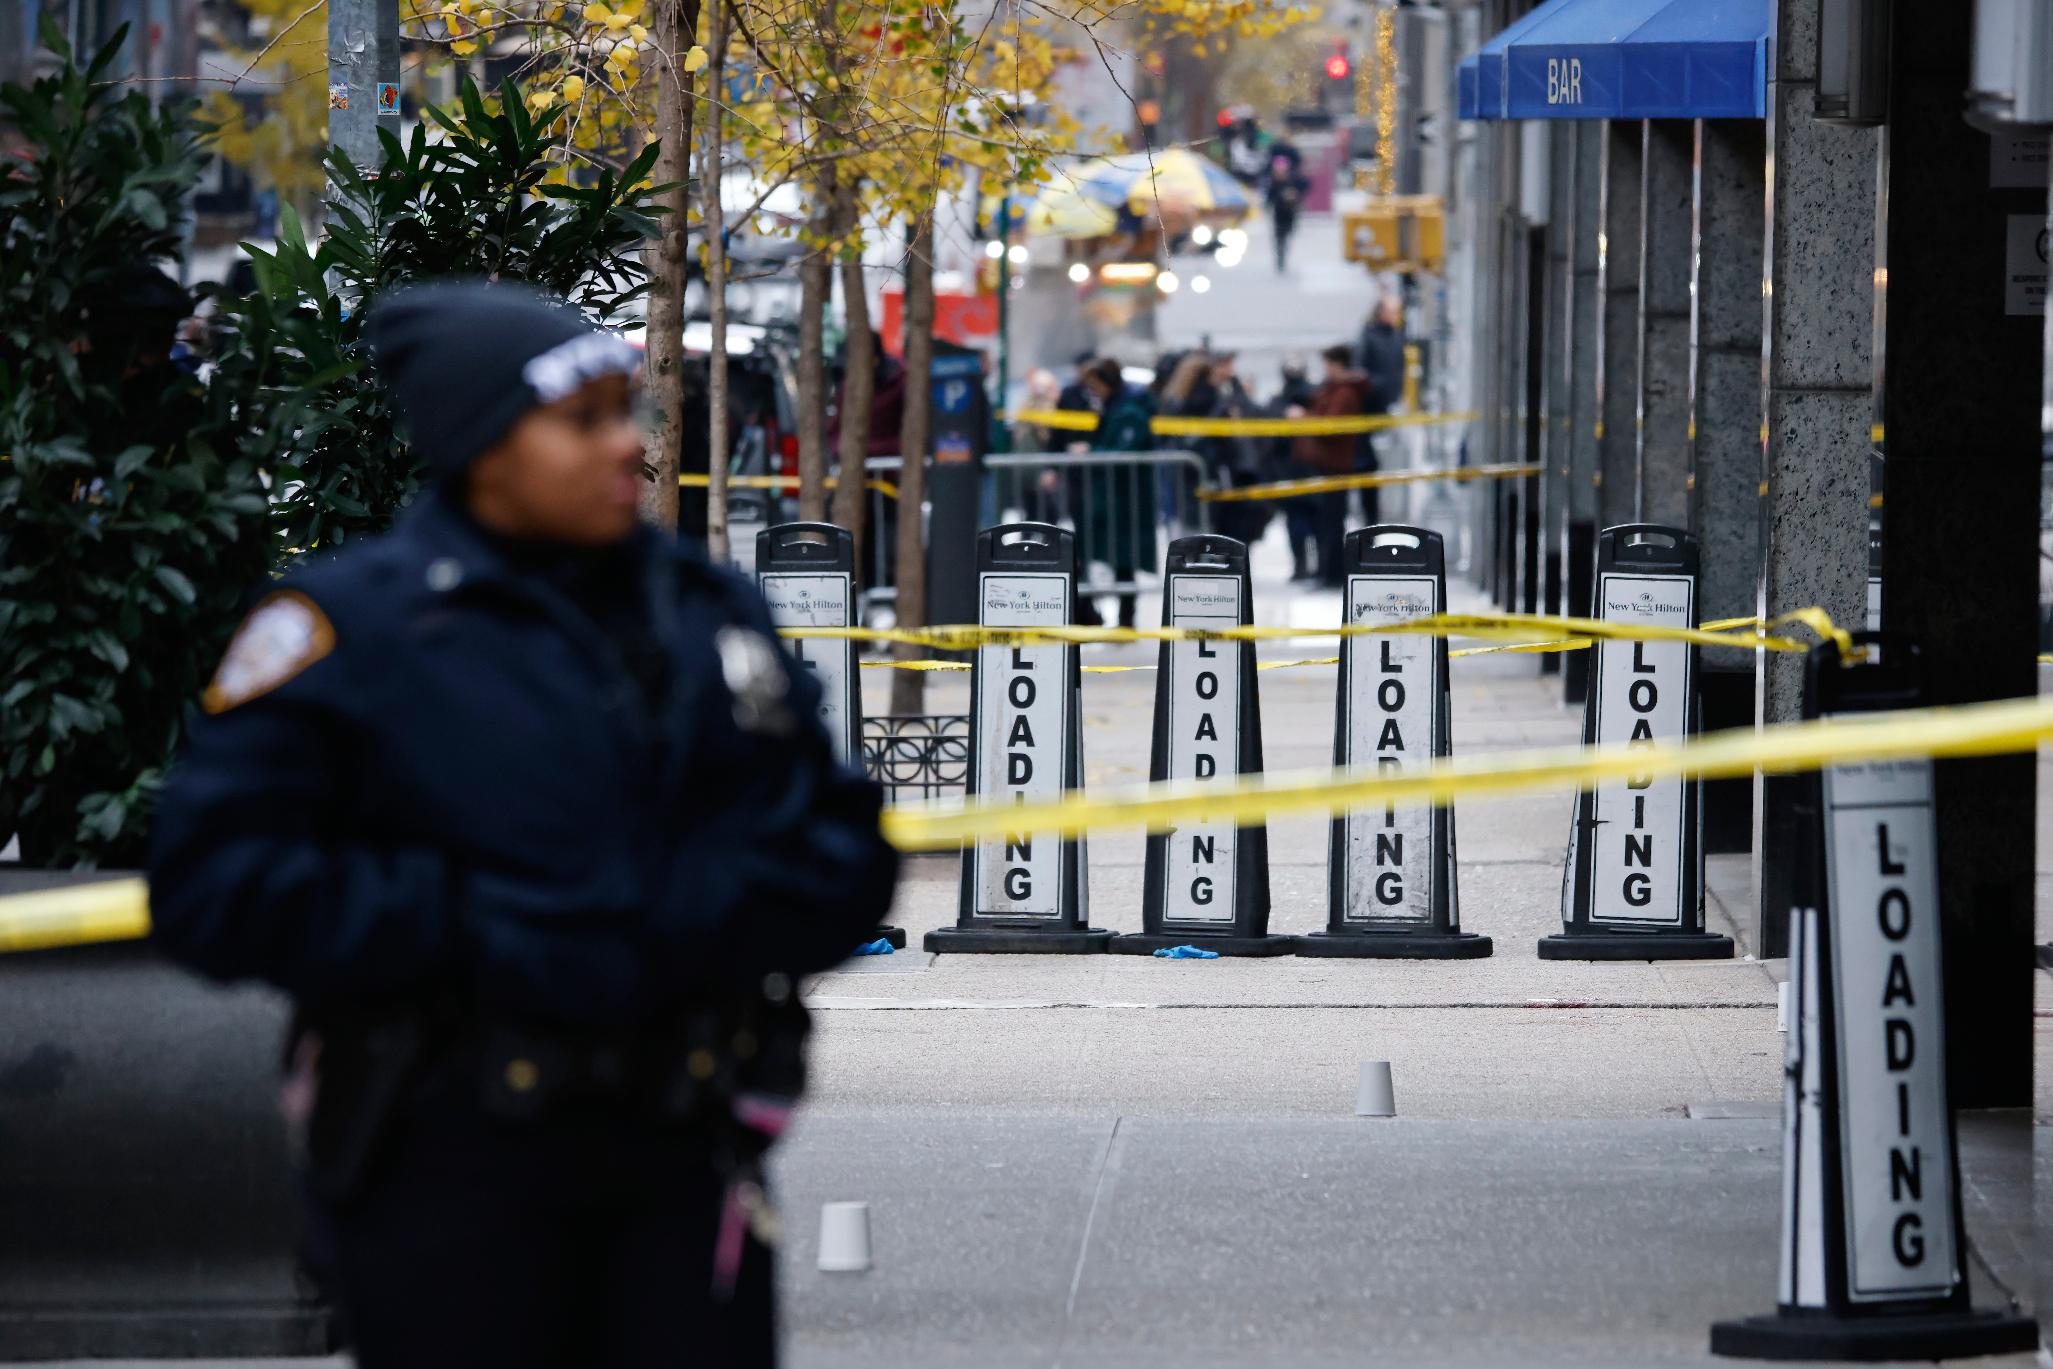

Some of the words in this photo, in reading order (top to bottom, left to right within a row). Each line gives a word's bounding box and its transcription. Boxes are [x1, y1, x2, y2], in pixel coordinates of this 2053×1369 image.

[1548, 58, 1582, 104] BAR
[1177, 595, 1194, 603] New
[1196, 595, 1212, 603] York
[1213, 595, 1236, 603] Hilton
[768, 601, 788, 609] New
[790, 601, 811, 609] York
[813, 600, 843, 609] Hilton
[987, 600, 1007, 609] New
[1010, 601, 1030, 610] York
[1033, 601, 1062, 610] Hilton
[1356, 603, 1376, 611] New
[1378, 603, 1399, 611] York
[1608, 602, 1629, 611] New
[1655, 603, 1685, 613] Hilton
[1190, 632, 1218, 906] LOADNG
[1876, 822, 1925, 1269] LOADING
